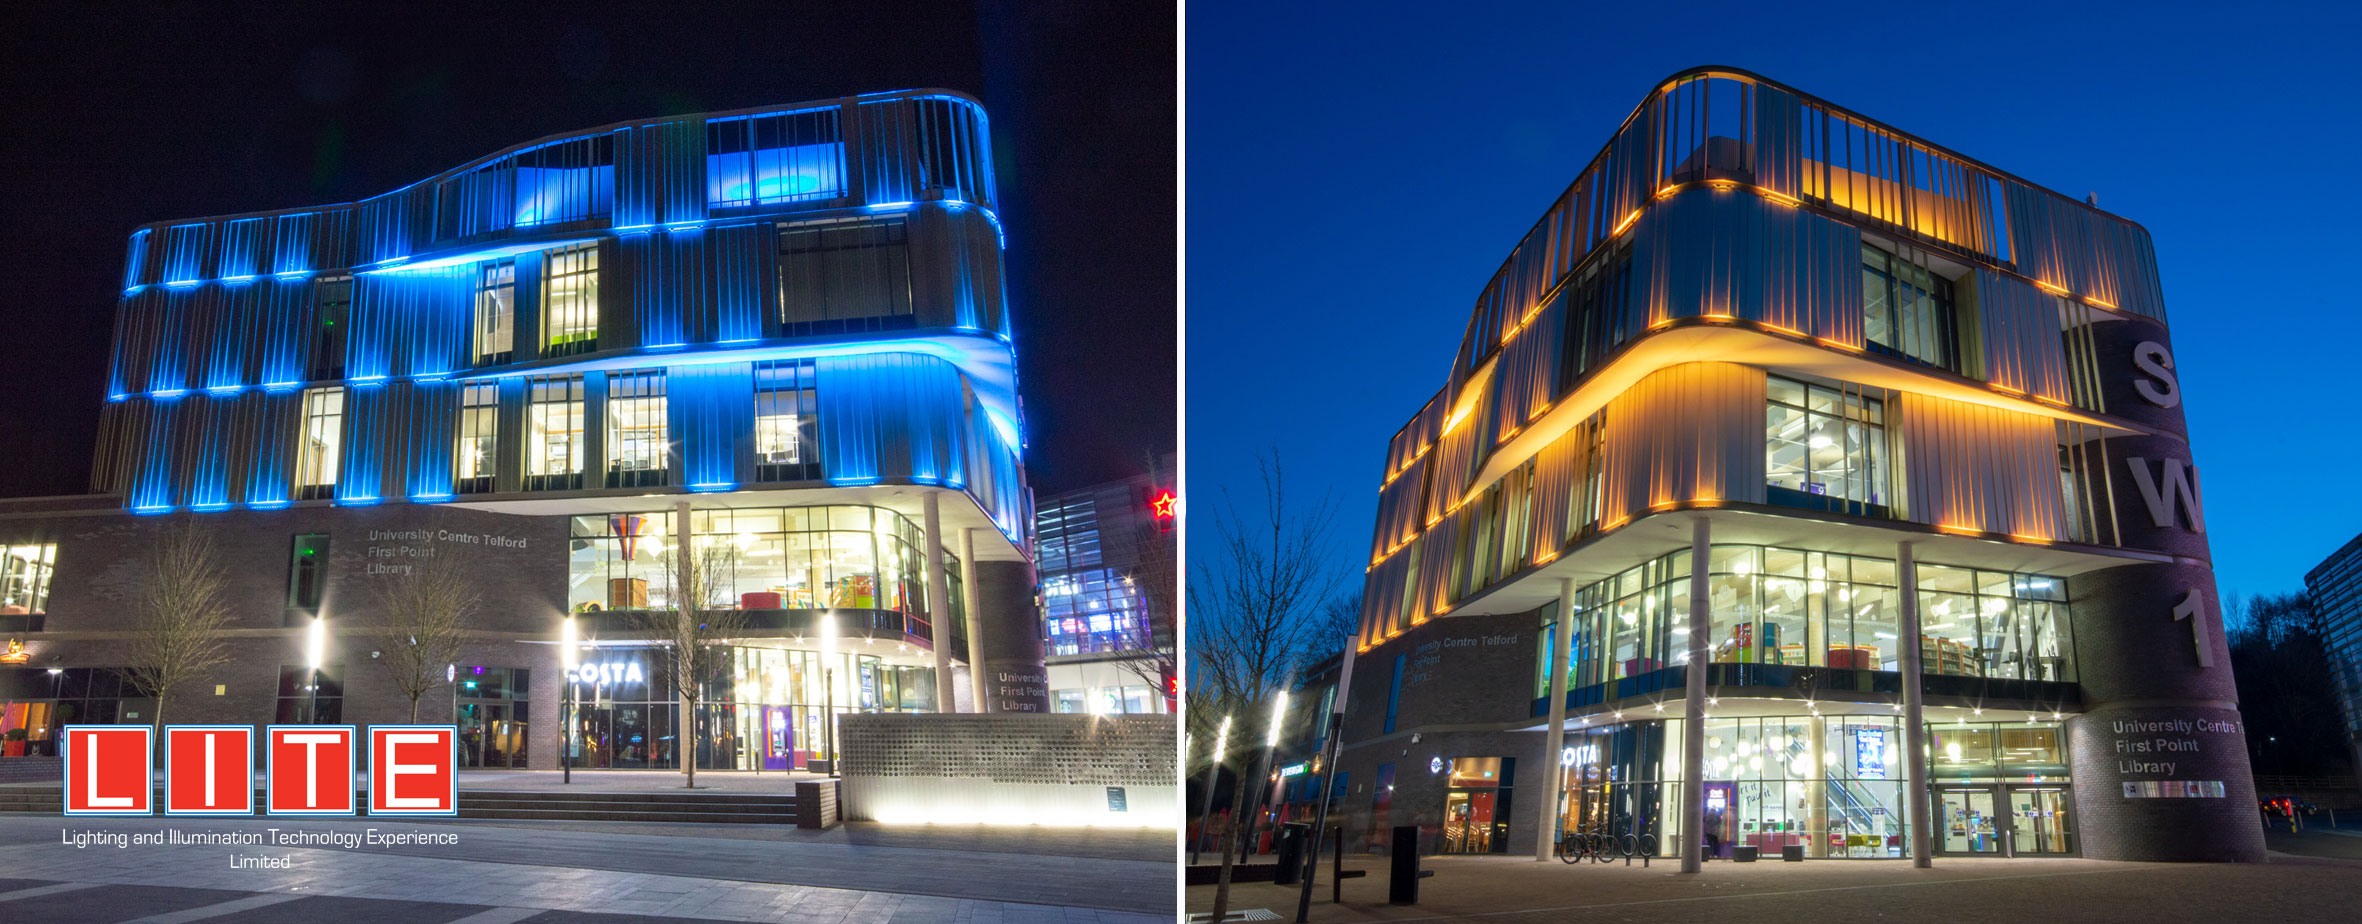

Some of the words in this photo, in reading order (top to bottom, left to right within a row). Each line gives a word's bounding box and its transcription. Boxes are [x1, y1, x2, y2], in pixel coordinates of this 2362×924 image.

[369, 529, 434, 542] University
[438, 529, 479, 544] Centre
[483, 534, 527, 548] Telford
[368, 546, 396, 557] First
[400, 546, 435, 557] Point
[367, 563, 412, 575] Library
[1443, 637, 1478, 648] Centre
[1481, 634, 1518, 646] Telford
[1000, 686, 1024, 697] First
[1026, 686, 1046, 697] Point
[1002, 700, 1037, 712] Library
[2113, 719, 2192, 735] University
[2197, 718, 2235, 733] Centre
[2116, 739, 2152, 753] First
[2156, 738, 2200, 752] Point
[1560, 744, 1597, 768] OSTA
[2120, 760, 2176, 776] Library
